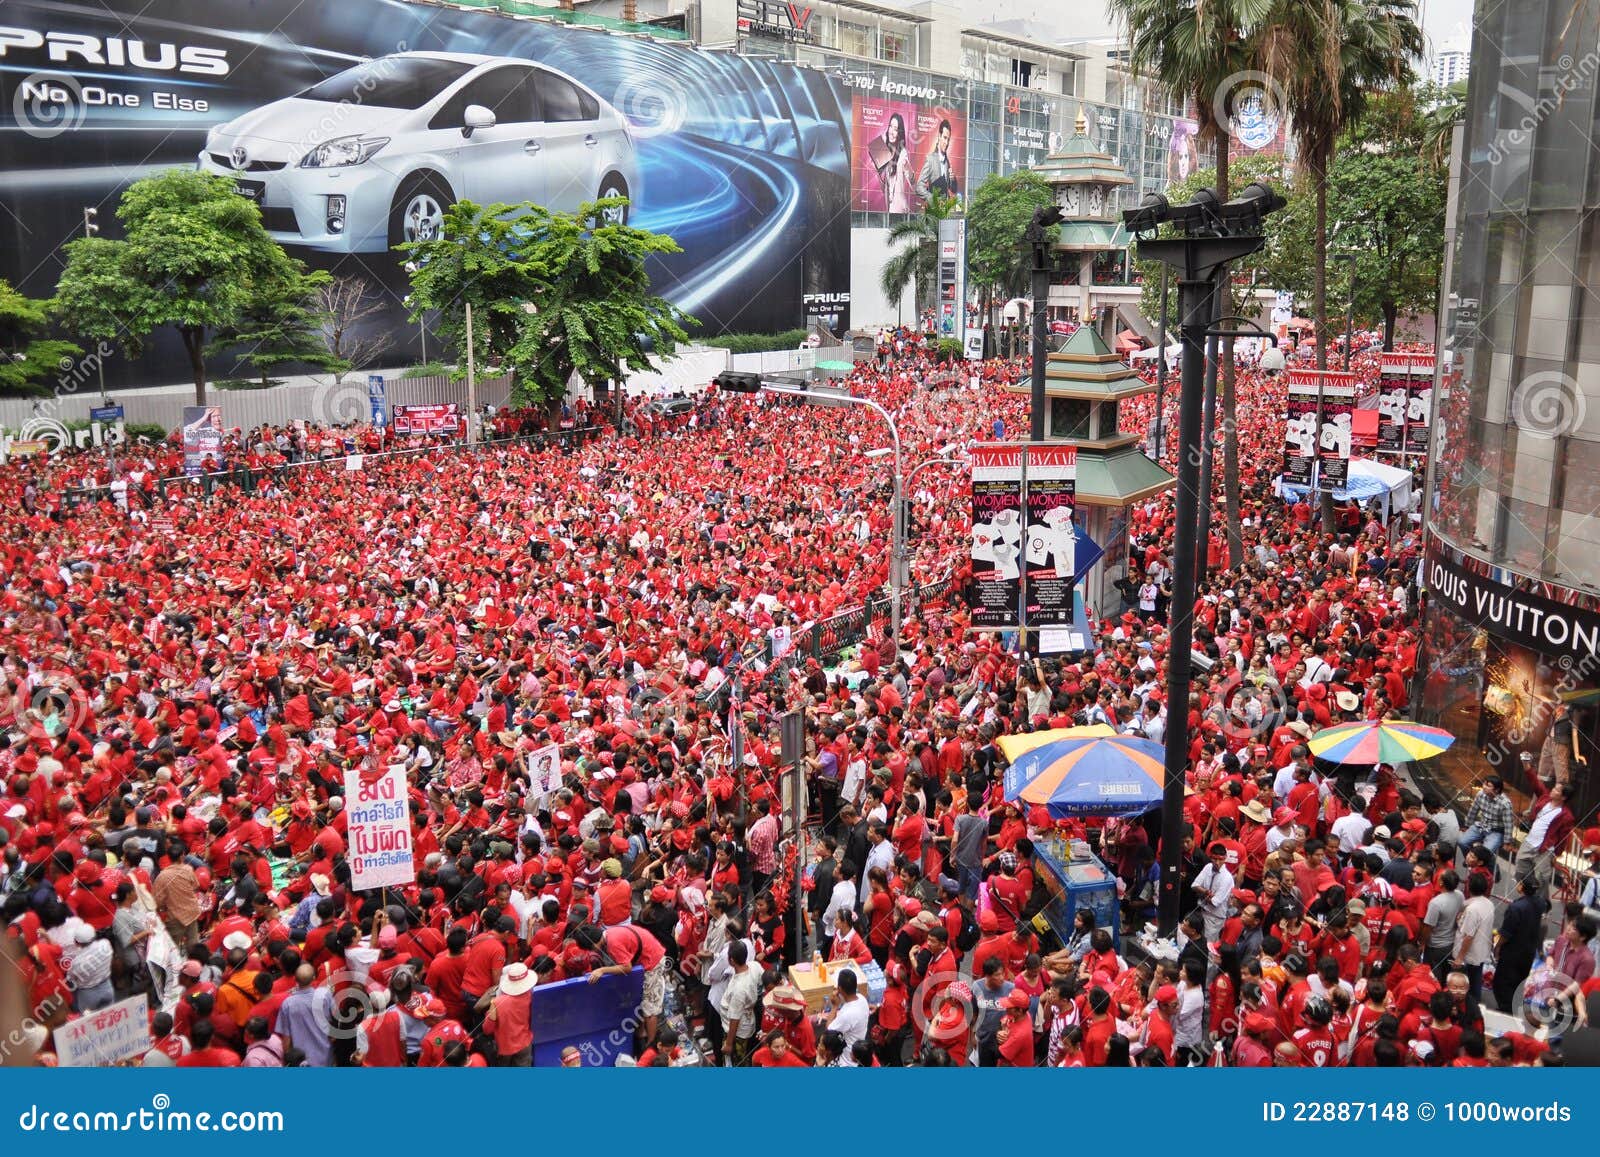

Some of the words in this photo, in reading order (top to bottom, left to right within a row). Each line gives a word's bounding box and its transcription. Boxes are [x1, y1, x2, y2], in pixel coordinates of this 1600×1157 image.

[751, 21, 783, 35] WORLD
[0, 26, 230, 76] PRIUS
[855, 75, 876, 90] YOU
[21, 82, 68, 102] No
[81, 86, 140, 108] One
[152, 91, 209, 113] Else
[803, 292, 850, 305] PRIUS
[809, 305, 819, 313] No
[1411, 358, 1435, 367] BAZAA
[973, 452, 1020, 467] BAZAAR
[1028, 451, 1076, 466] BAZAAR
[972, 495, 1020, 506] WOMEN
[1027, 494, 1075, 506] WOMEN
[1430, 560, 1468, 606] LOUIS
[1474, 585, 1599, 657] VUITTON
